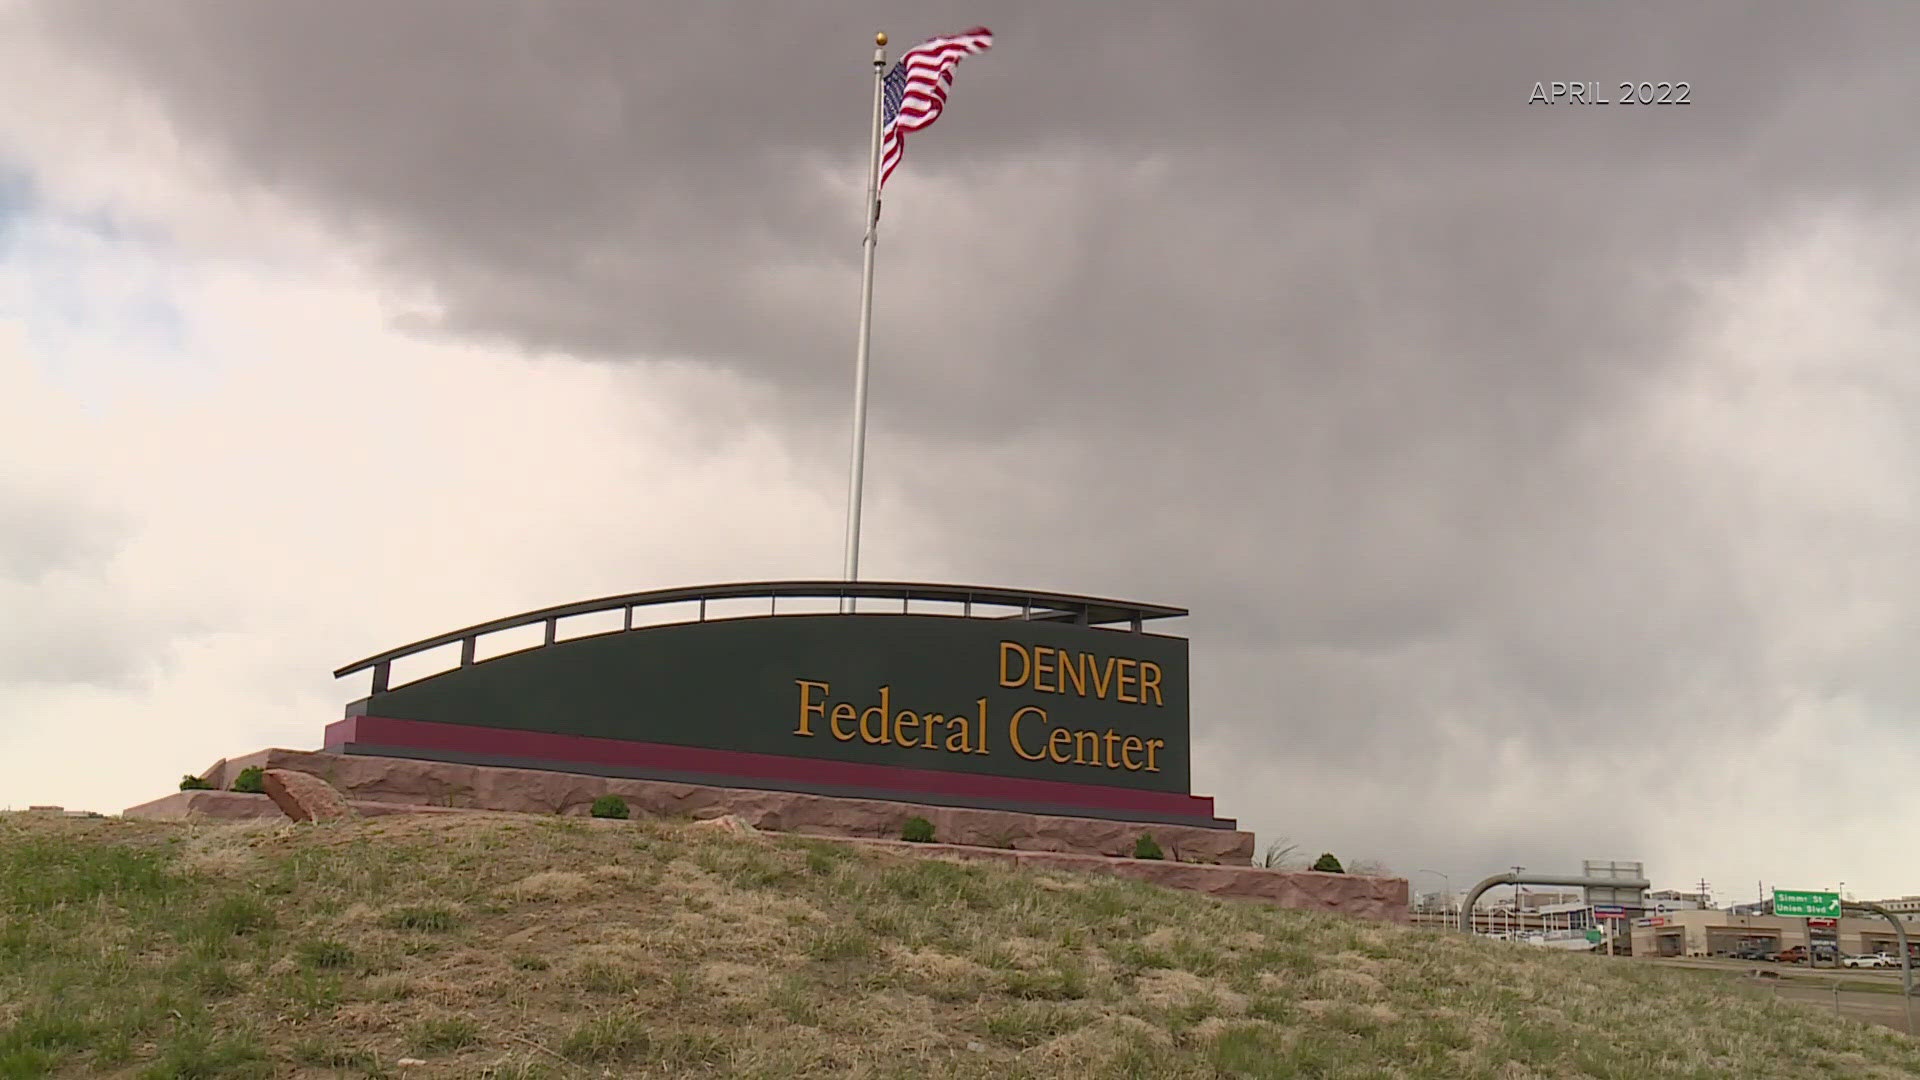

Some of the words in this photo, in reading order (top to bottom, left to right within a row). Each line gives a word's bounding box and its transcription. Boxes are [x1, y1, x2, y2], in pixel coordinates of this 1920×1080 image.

[999, 641, 1164, 706] DENVER
[793, 679, 989, 755] Federal
[1008, 706, 1164, 772] Center
[1776, 903, 1803, 912] Union
[1806, 905, 1827, 913] Blvd
[1812, 895, 1823, 903] St
